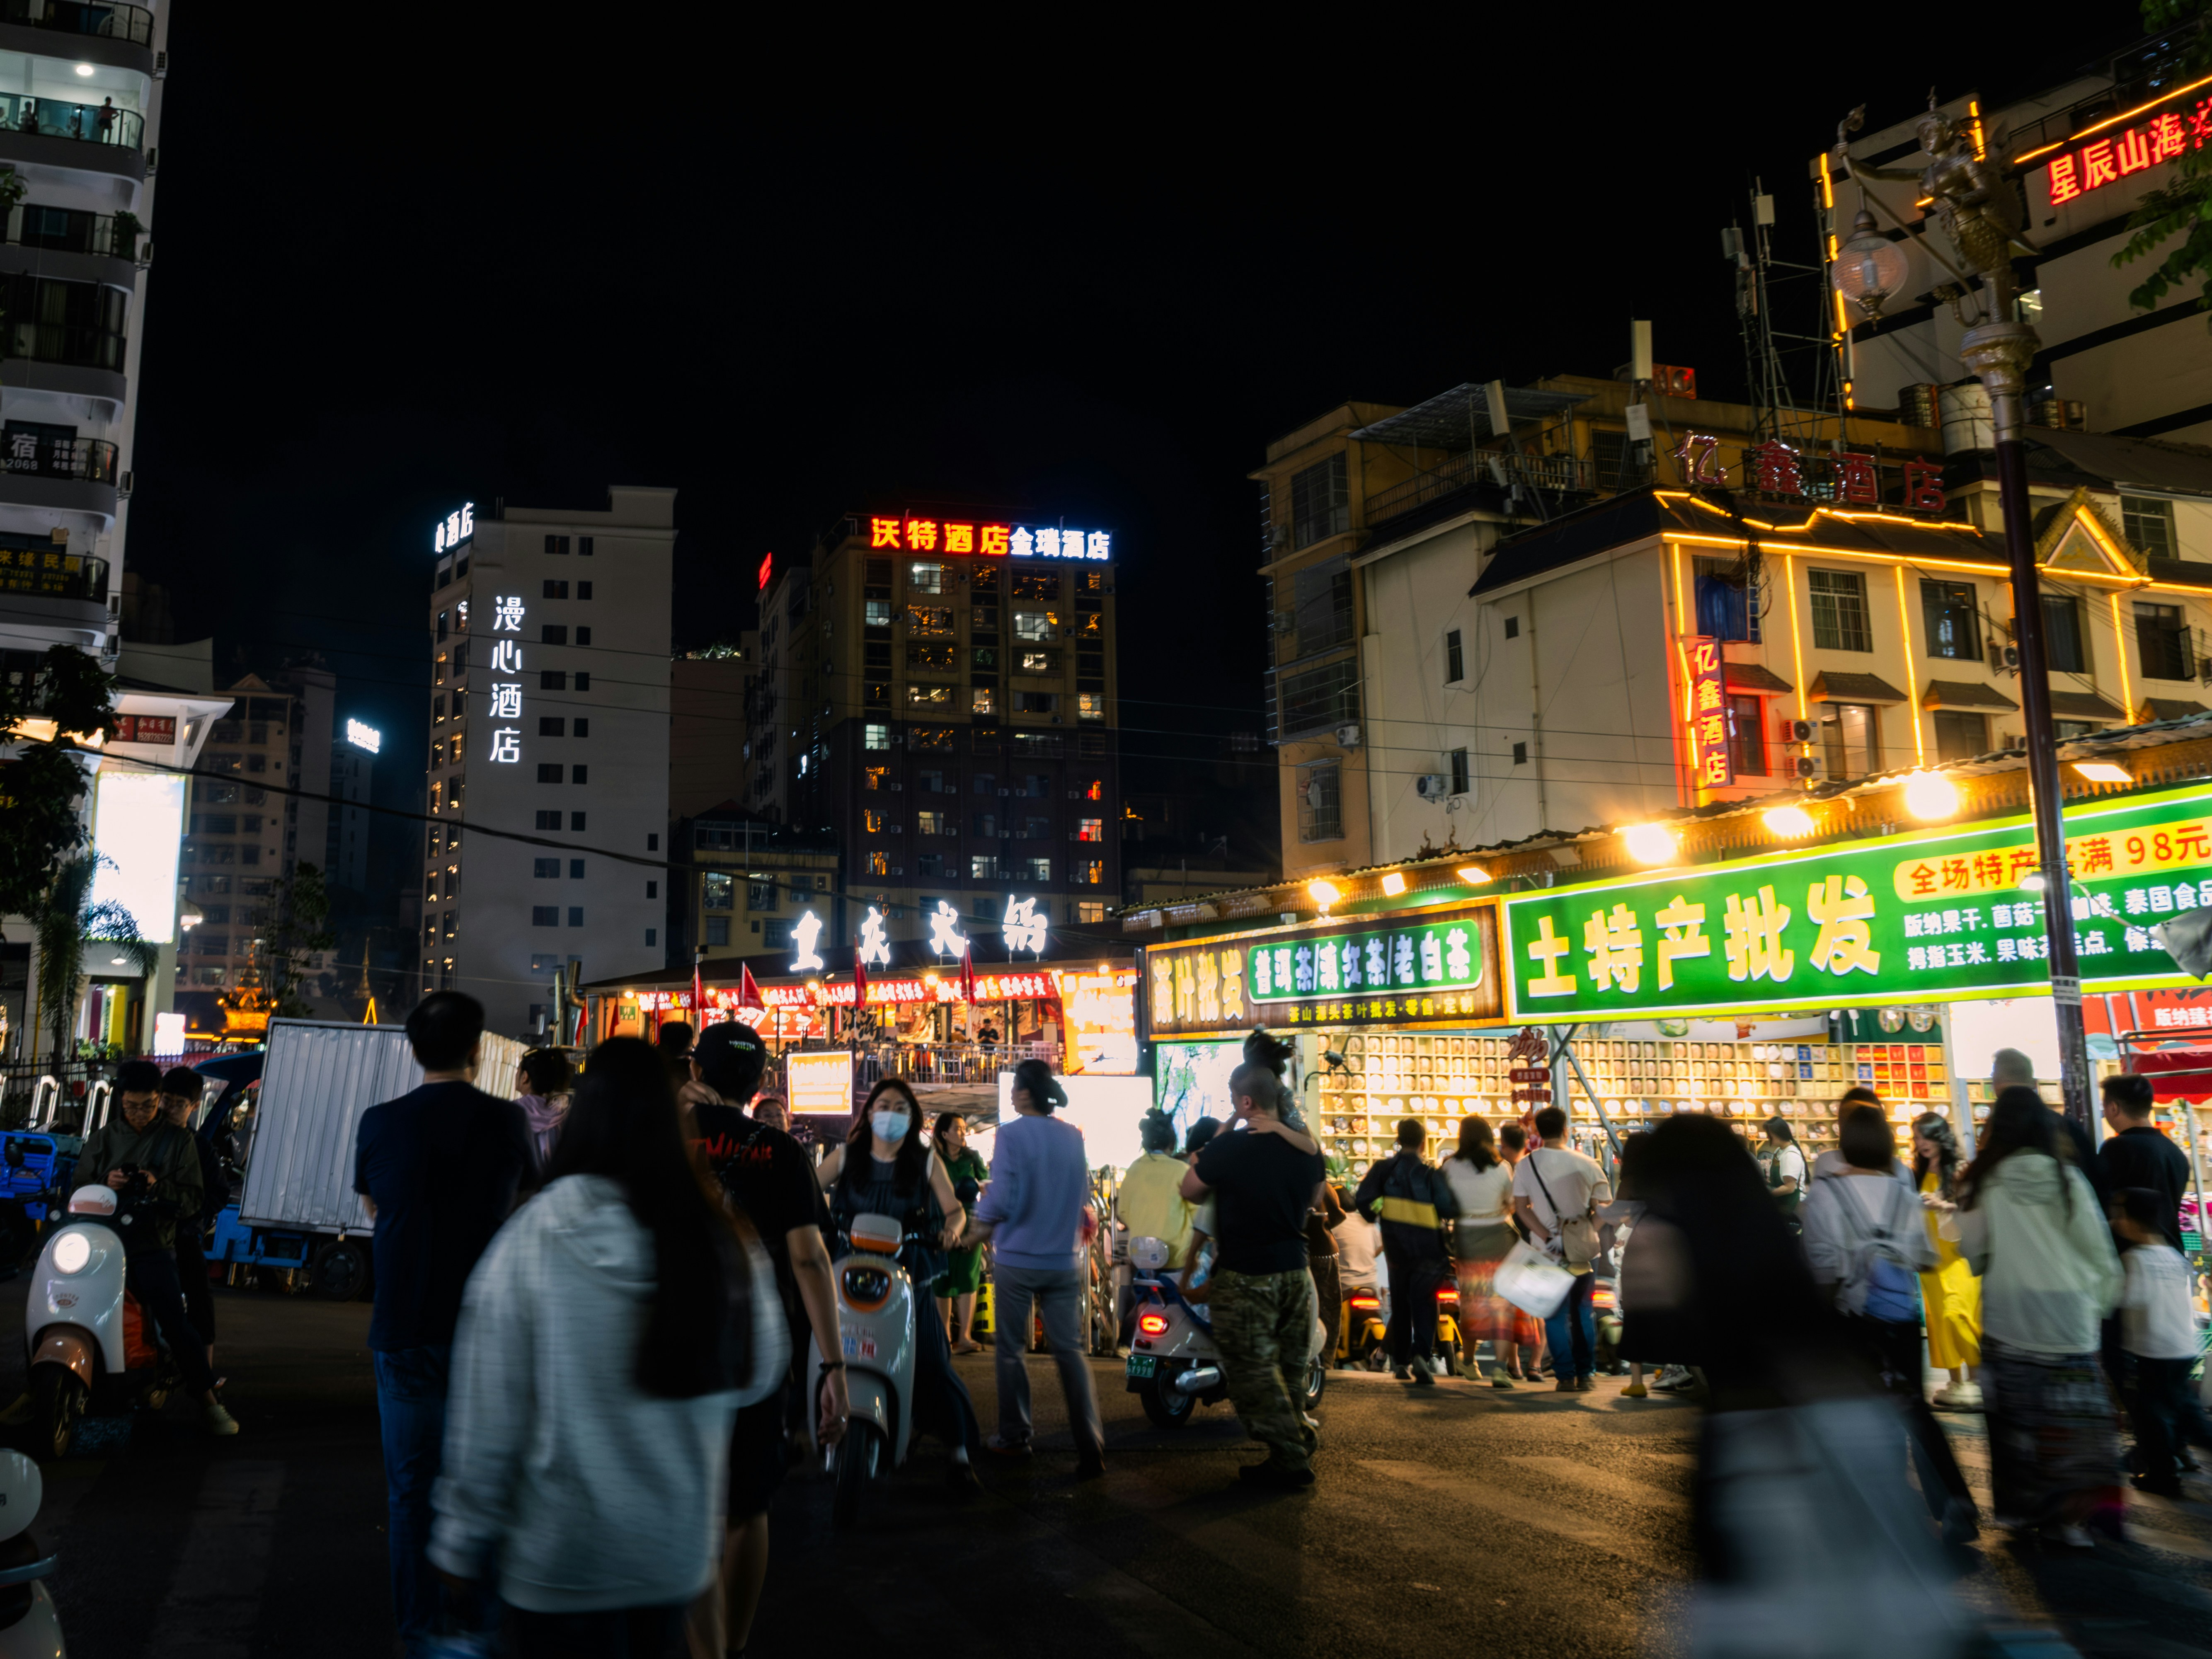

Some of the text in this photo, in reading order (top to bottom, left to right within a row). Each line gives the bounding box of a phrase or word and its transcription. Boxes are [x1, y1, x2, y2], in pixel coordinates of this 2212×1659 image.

[6, 458, 38, 470] 2068
[10, 433, 38, 459] 宿
[1674, 430, 1946, 511] 亿鑫酒店
[871, 518, 1010, 556] 沃特酒店
[1010, 526, 1111, 560] 金瑞酒店
[489, 596, 525, 763] 漫心酒店
[1694, 643, 1727, 785] 亿鑫酒店
[1910, 825, 2212, 895] 全场特产满 98元
[1527, 874, 1880, 998] 土特产批发
[1153, 948, 1245, 1024] 茶叶批发
